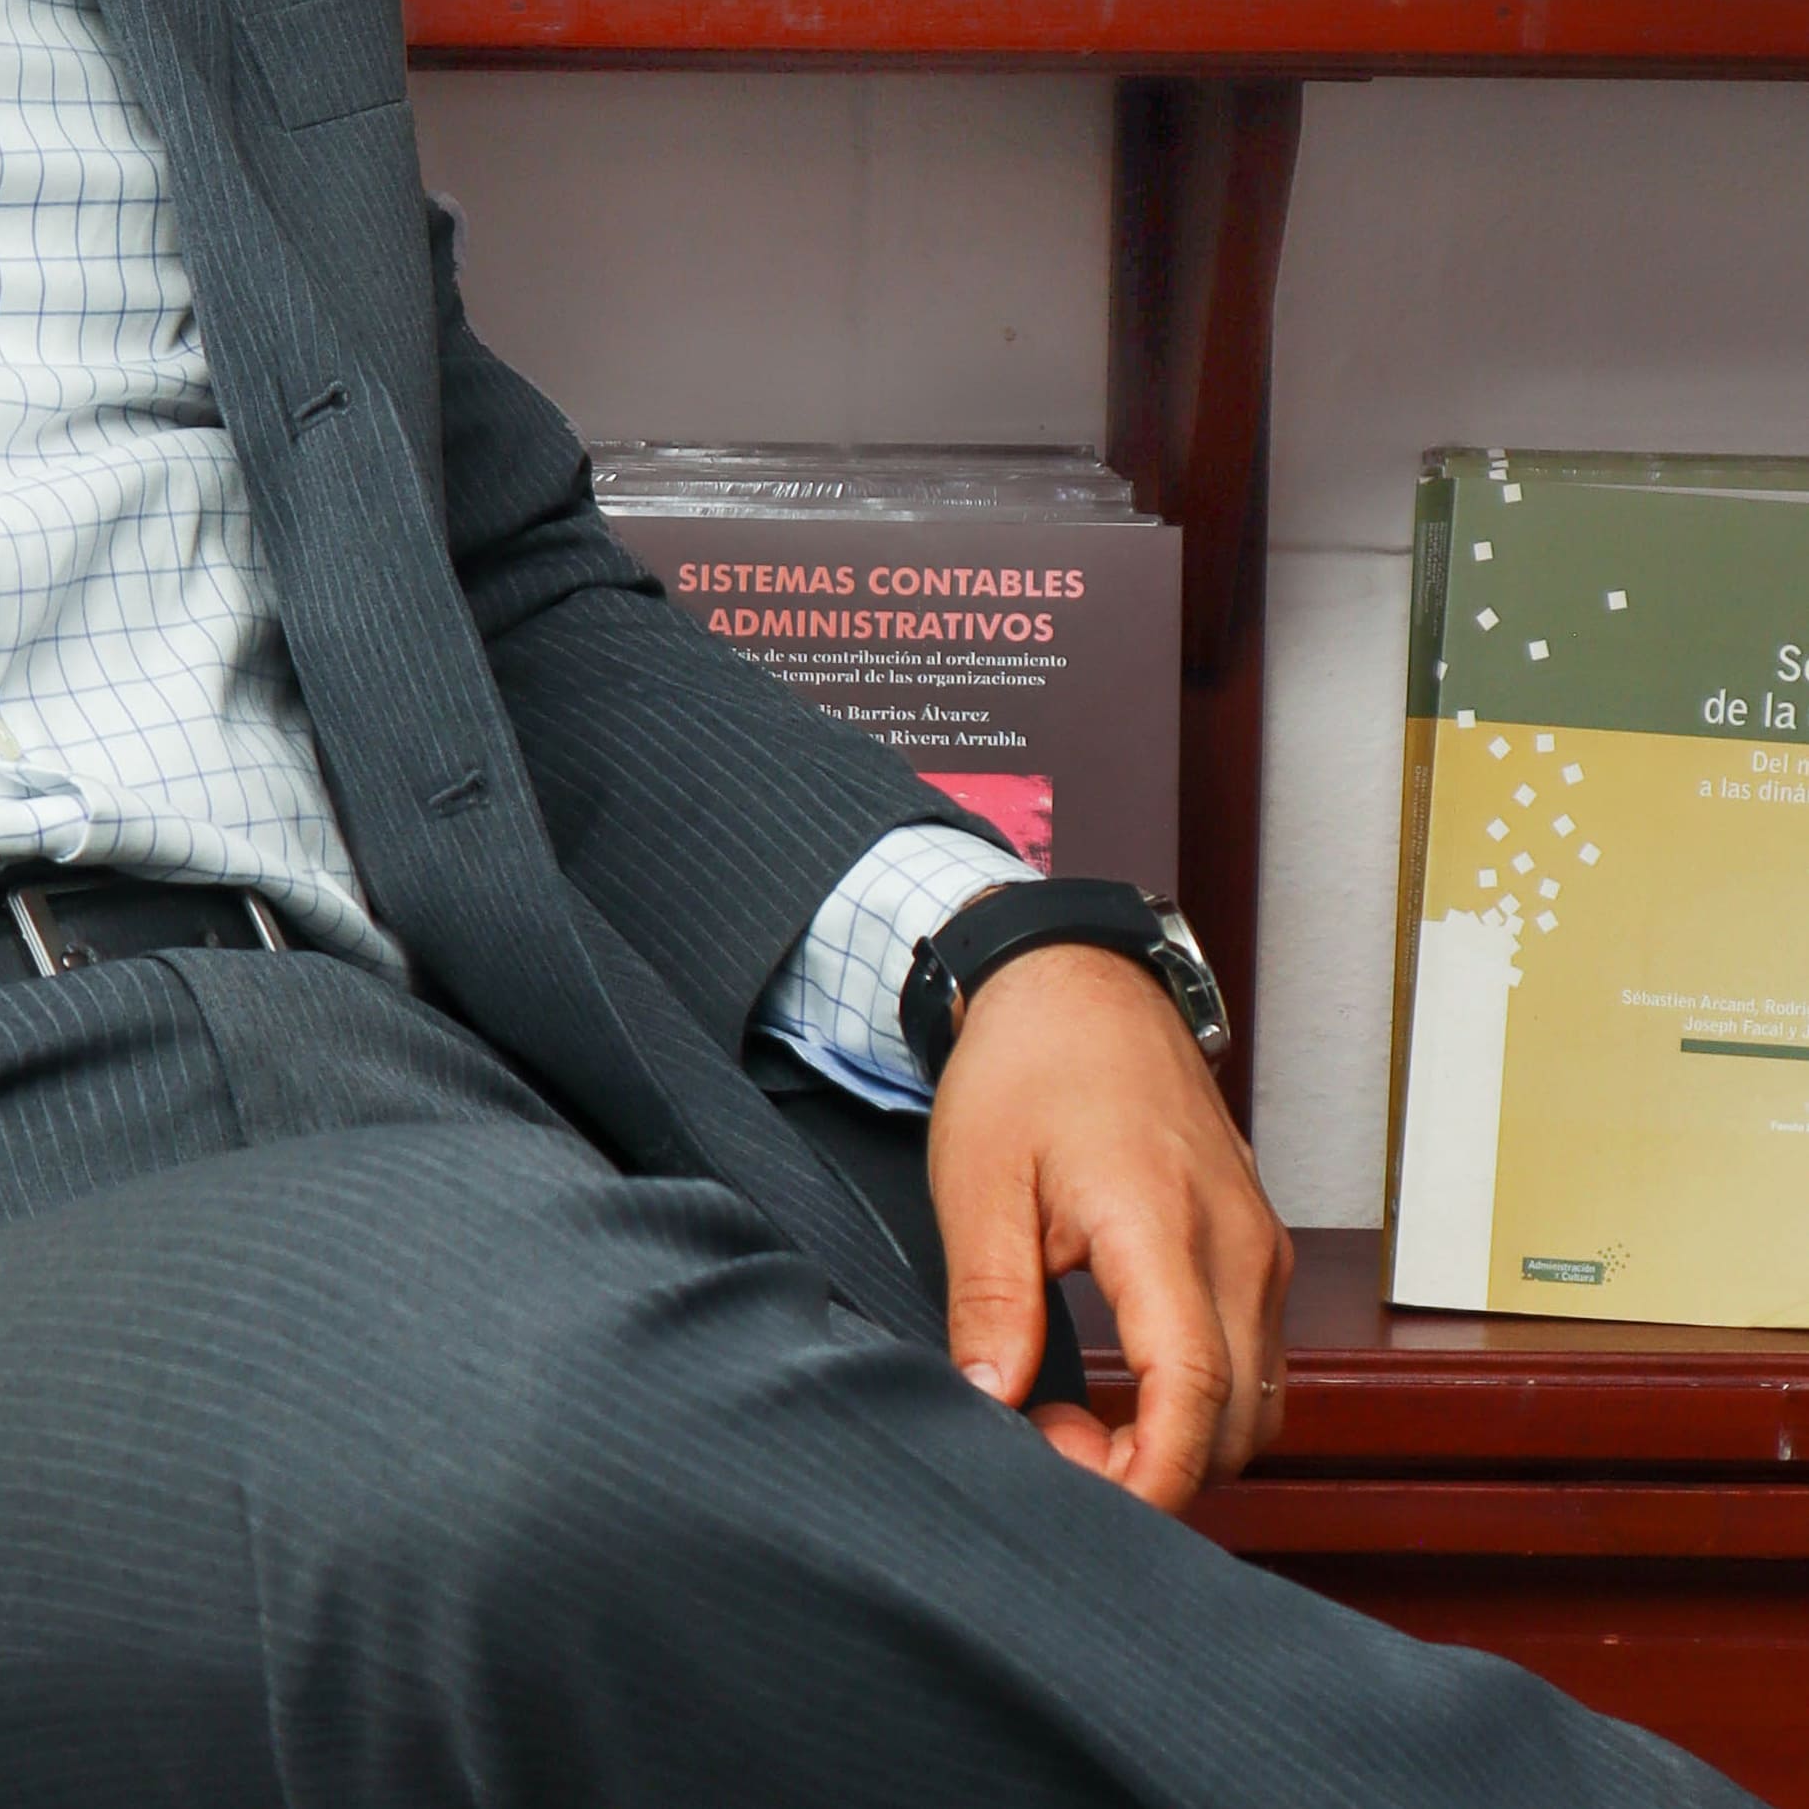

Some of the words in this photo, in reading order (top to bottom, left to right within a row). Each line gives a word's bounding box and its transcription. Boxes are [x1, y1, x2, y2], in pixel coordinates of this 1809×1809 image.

[677, 563, 855, 595] SISTEMAS
[868, 567, 1085, 599] CONTABLES
[707, 608, 1054, 642] ADMINISTRATIVOS
[764, 648, 785, 663] de
[789, 651, 808, 663] su
[812, 649, 922, 665] contribución
[926, 651, 941, 665] al
[945, 651, 1068, 668] ordenamiento
[1778, 644, 1809, 682] S
[864, 669, 886, 684] de
[889, 669, 913, 684] las
[917, 670, 1047, 688] organizaciones
[847, 704, 917, 722] Barrios
[920, 703, 991, 722] Álvarez
[1704, 688, 1748, 726] de
[1764, 691, 1797, 730] la
[889, 729, 950, 746] Rivera
[954, 731, 1028, 748] Arrubla
[1751, 750, 1789, 774] Del
[1699, 779, 1712, 797] a
[1721, 777, 1751, 800] las
[1758, 779, 1809, 804] diná
[1621, 989, 1696, 1009] Sébastien
[1700, 995, 1759, 1015] Arcand,
[1684, 1016, 1737, 1036] Joseph
[1742, 1019, 1783, 1037] Facal
